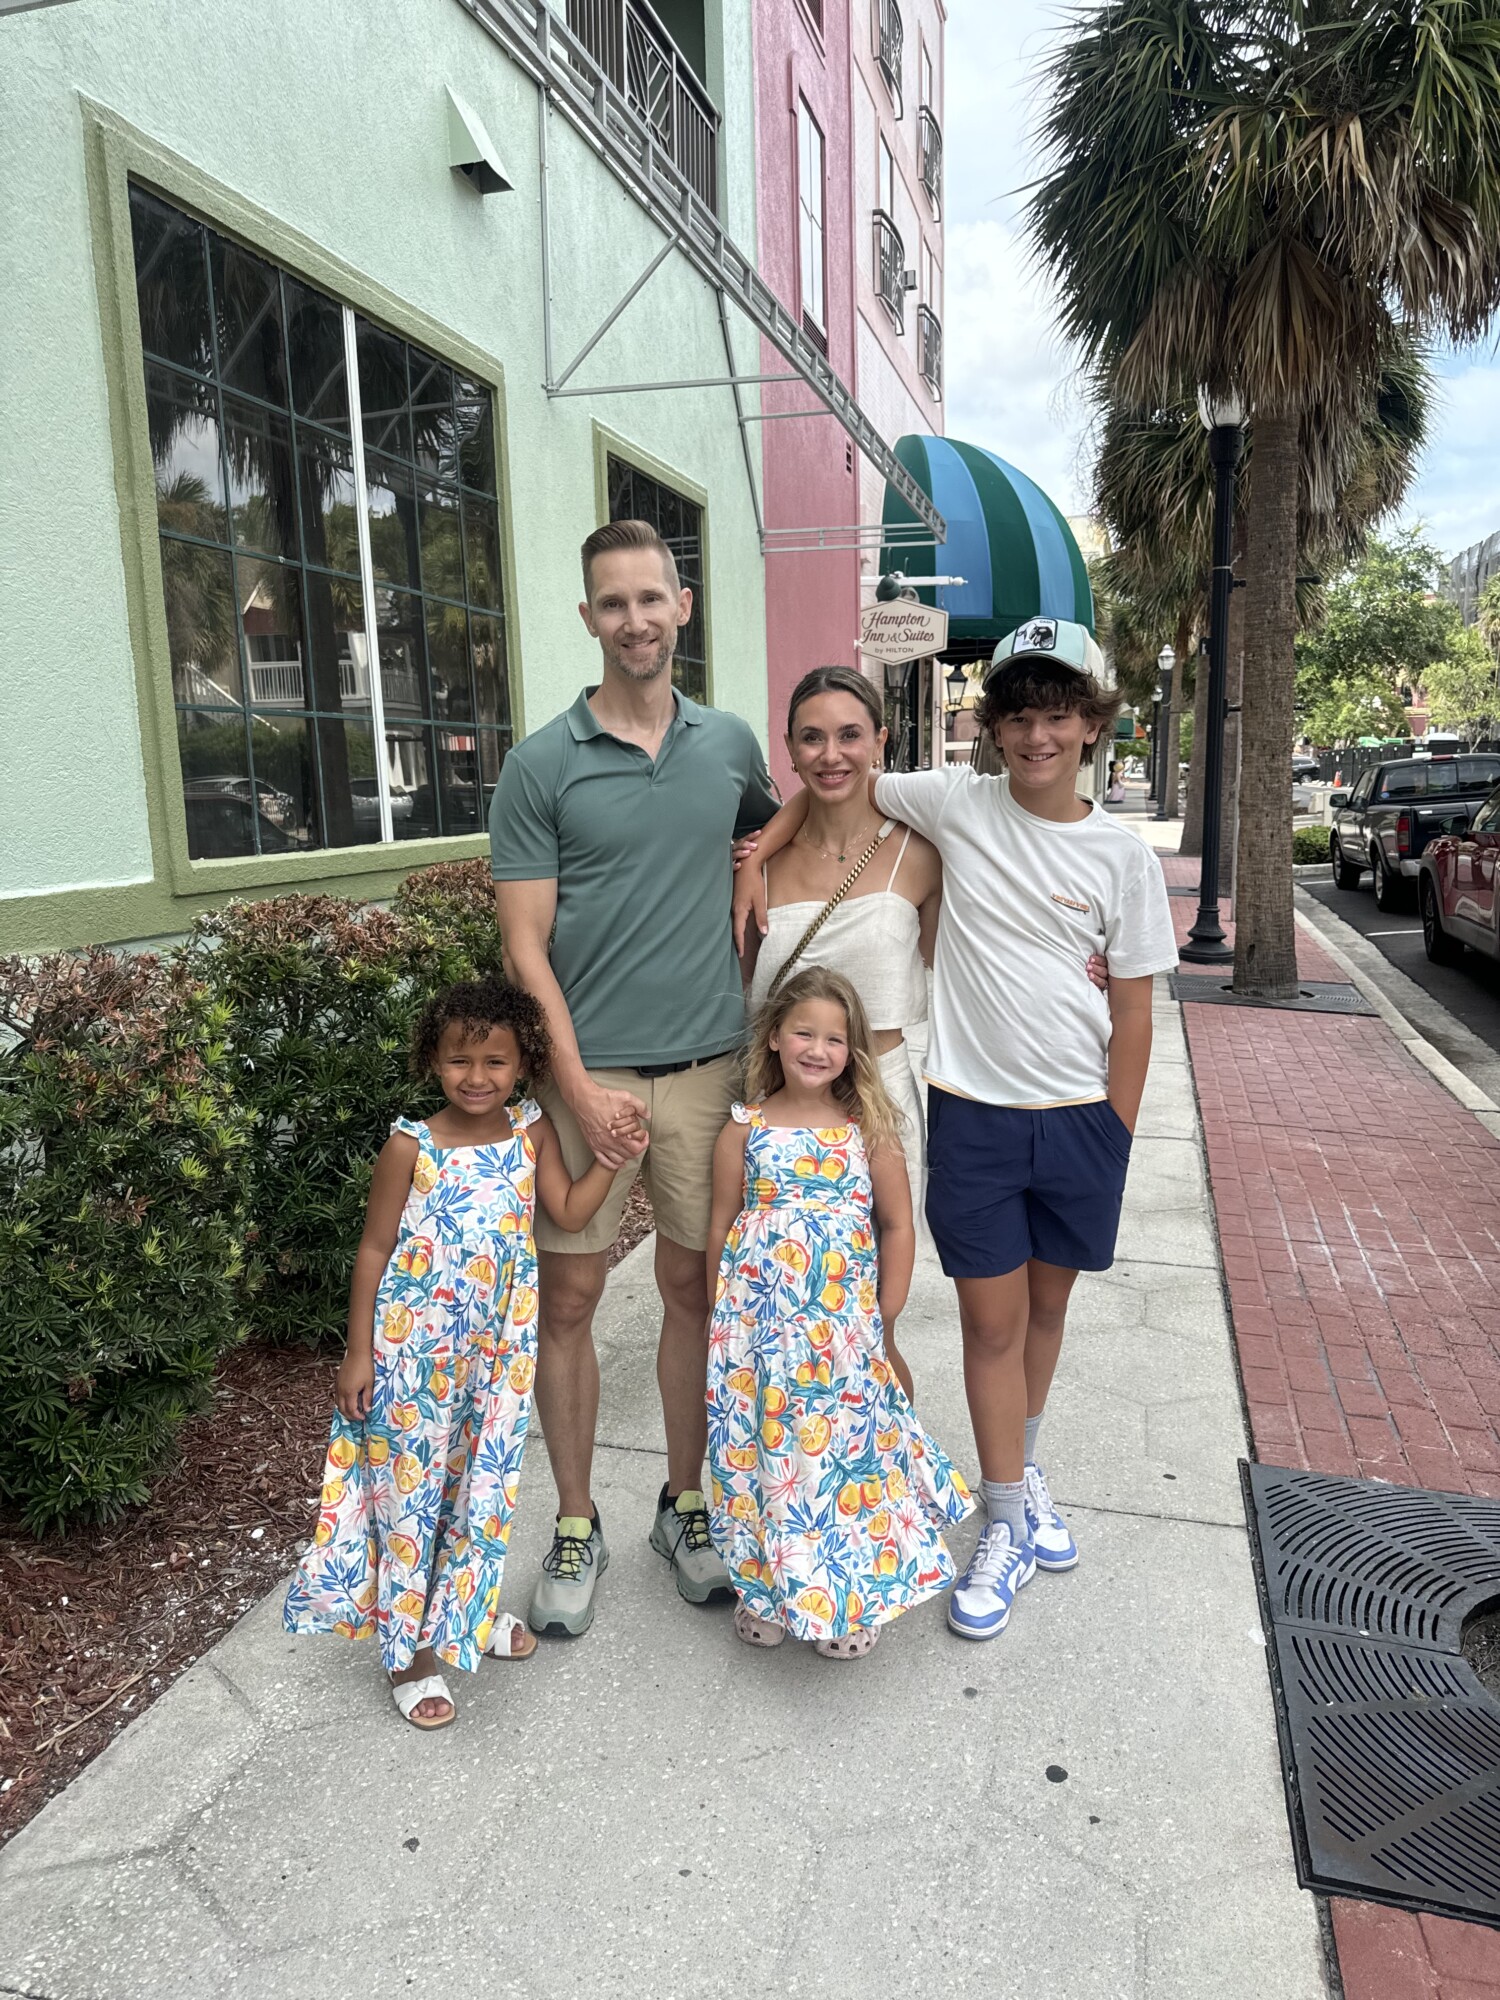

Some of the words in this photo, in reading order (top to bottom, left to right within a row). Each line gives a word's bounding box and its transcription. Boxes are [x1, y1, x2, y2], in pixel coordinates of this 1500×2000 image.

[861, 611, 930, 629] Hampton
[861, 629, 889, 643] Inn
[890, 633, 899, 643] &
[898, 628, 934, 642] Suites
